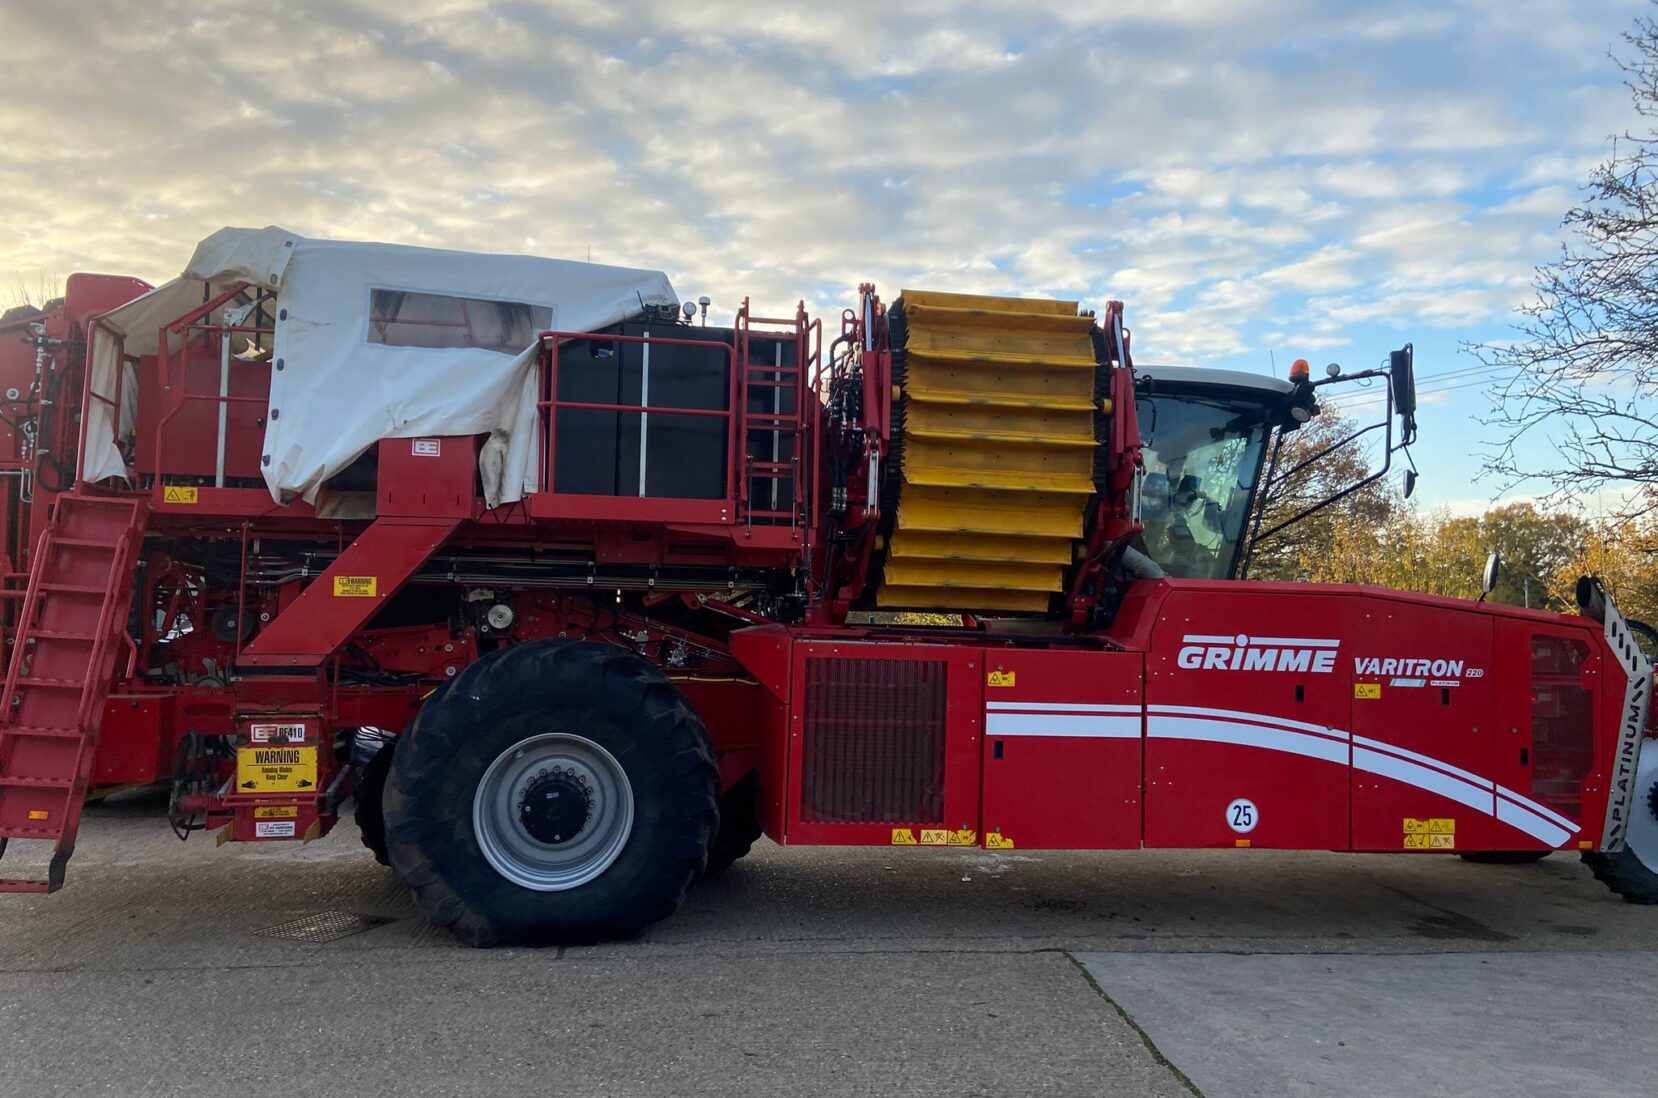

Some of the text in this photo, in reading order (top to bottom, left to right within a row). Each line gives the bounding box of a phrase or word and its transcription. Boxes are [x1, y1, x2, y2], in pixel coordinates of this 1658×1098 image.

[1177, 635, 1340, 672] GRIMME
[1354, 657, 1484, 678] VARITRON 220
[255, 750, 300, 764] WARNING
[1612, 704, 1641, 822] PLATINUM
[1233, 805, 1251, 826] 25
